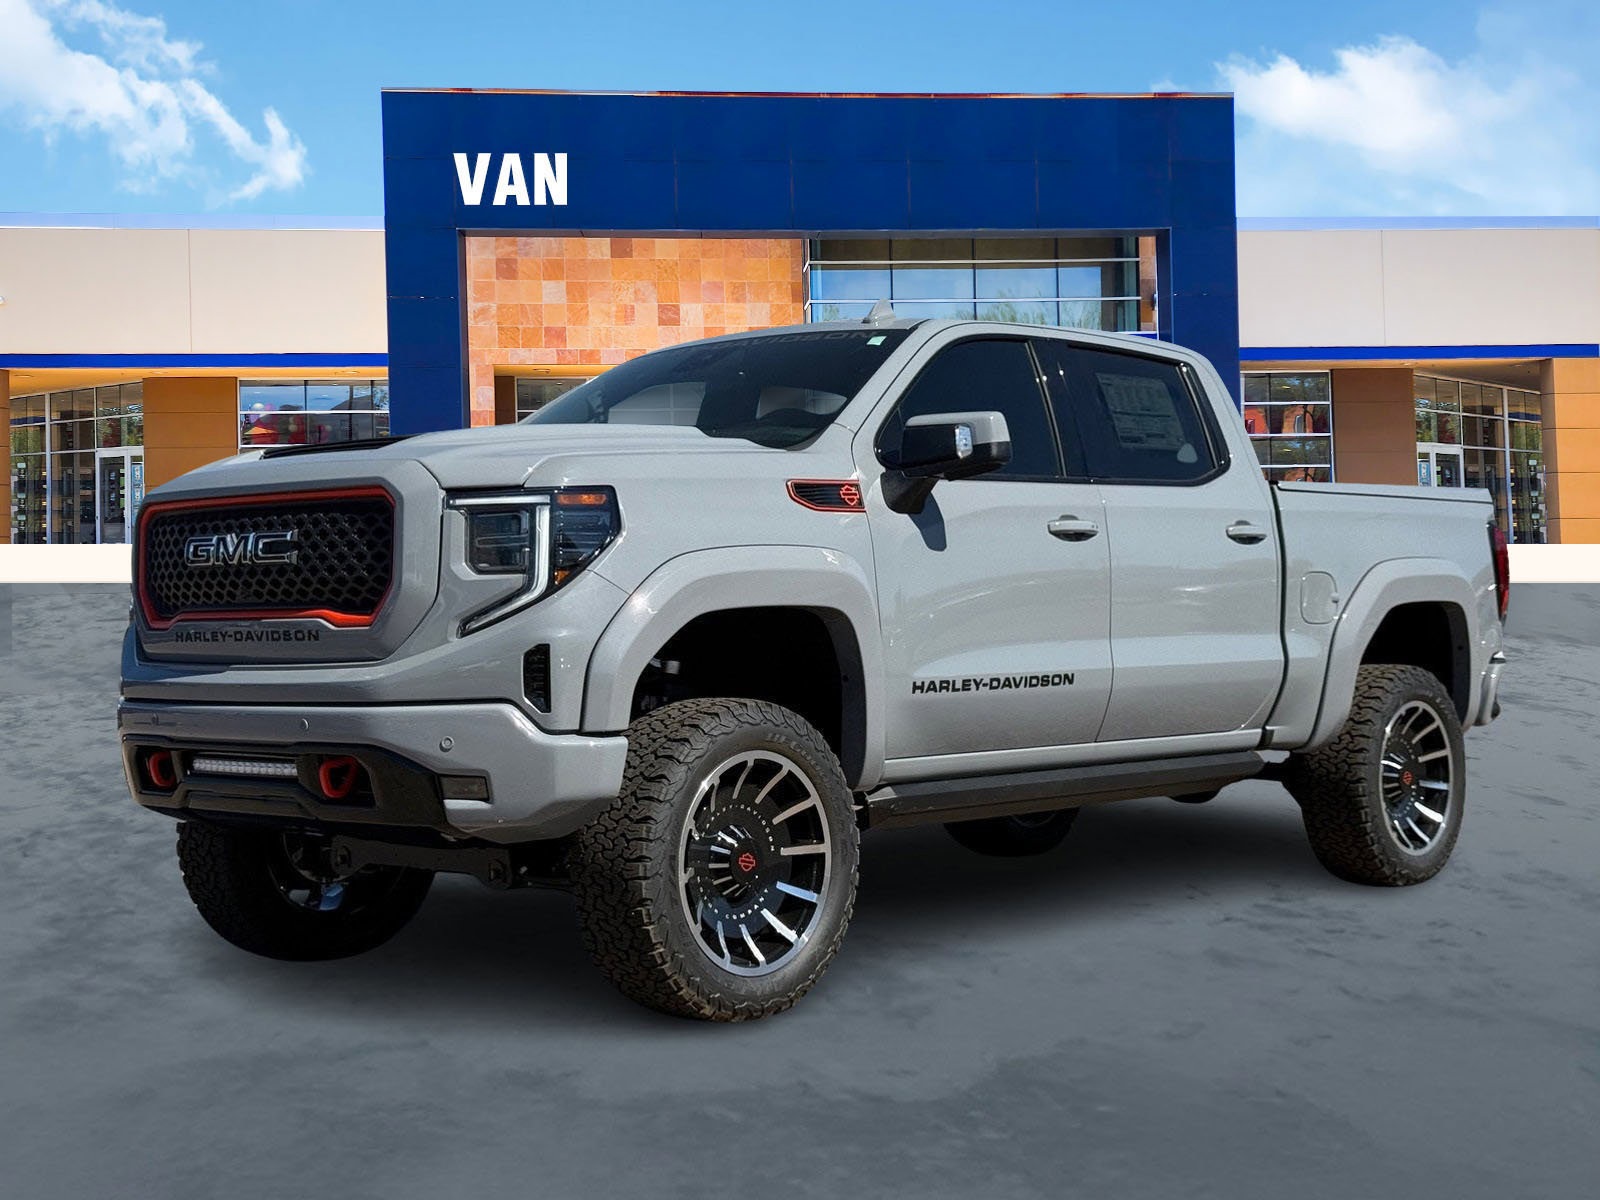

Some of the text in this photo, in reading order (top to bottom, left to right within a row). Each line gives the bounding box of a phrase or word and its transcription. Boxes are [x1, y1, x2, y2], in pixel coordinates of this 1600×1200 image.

[453, 152, 568, 206] VAN
[184, 528, 299, 567] GMC
[175, 629, 320, 643] HARLEY-DAVIDSON
[911, 673, 1075, 695] HARLEY-DAVIDSON
